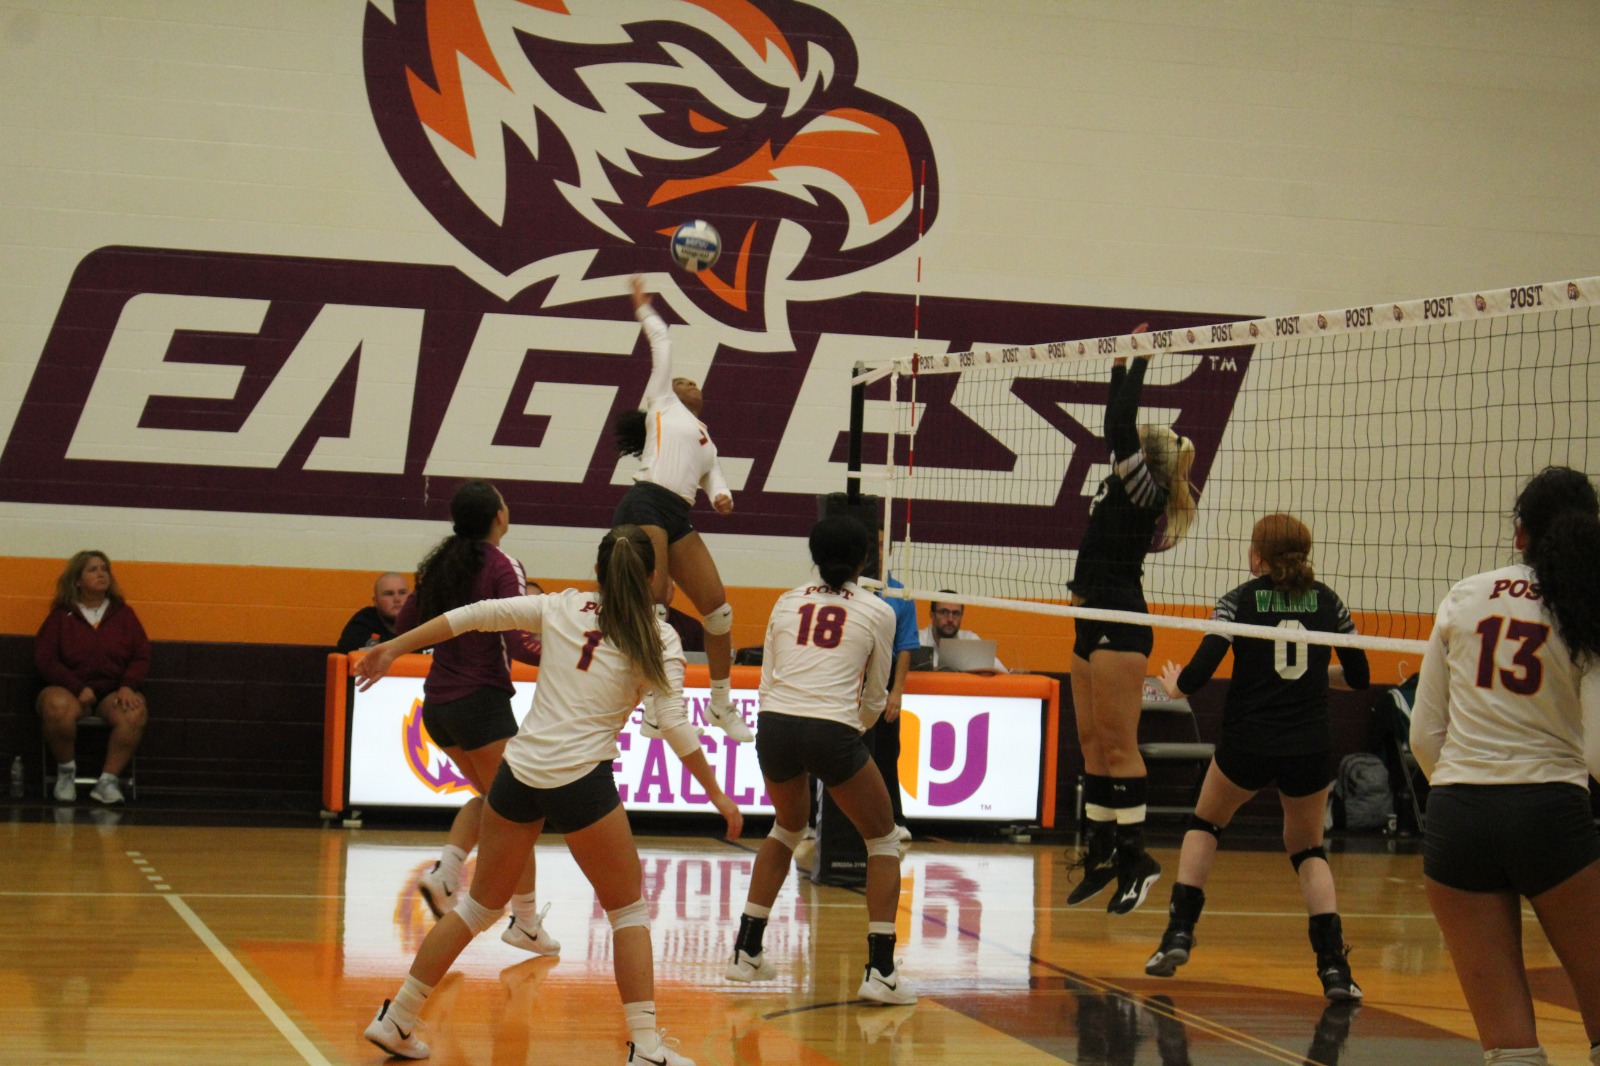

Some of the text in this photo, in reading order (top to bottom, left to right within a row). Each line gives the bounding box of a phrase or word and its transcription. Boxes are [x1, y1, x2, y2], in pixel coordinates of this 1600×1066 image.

[919, 285, 1544, 370] POST POST POST POST POST POST POST POST POST POST POST
[64, 292, 1203, 507] EAGLES
[1489, 578, 1541, 601] POS
[576, 630, 604, 673] 1
[796, 602, 848, 650] 18
[1274, 619, 1309, 680] 0
[1474, 614, 1551, 697] 13
[612, 732, 775, 806] EAGL
